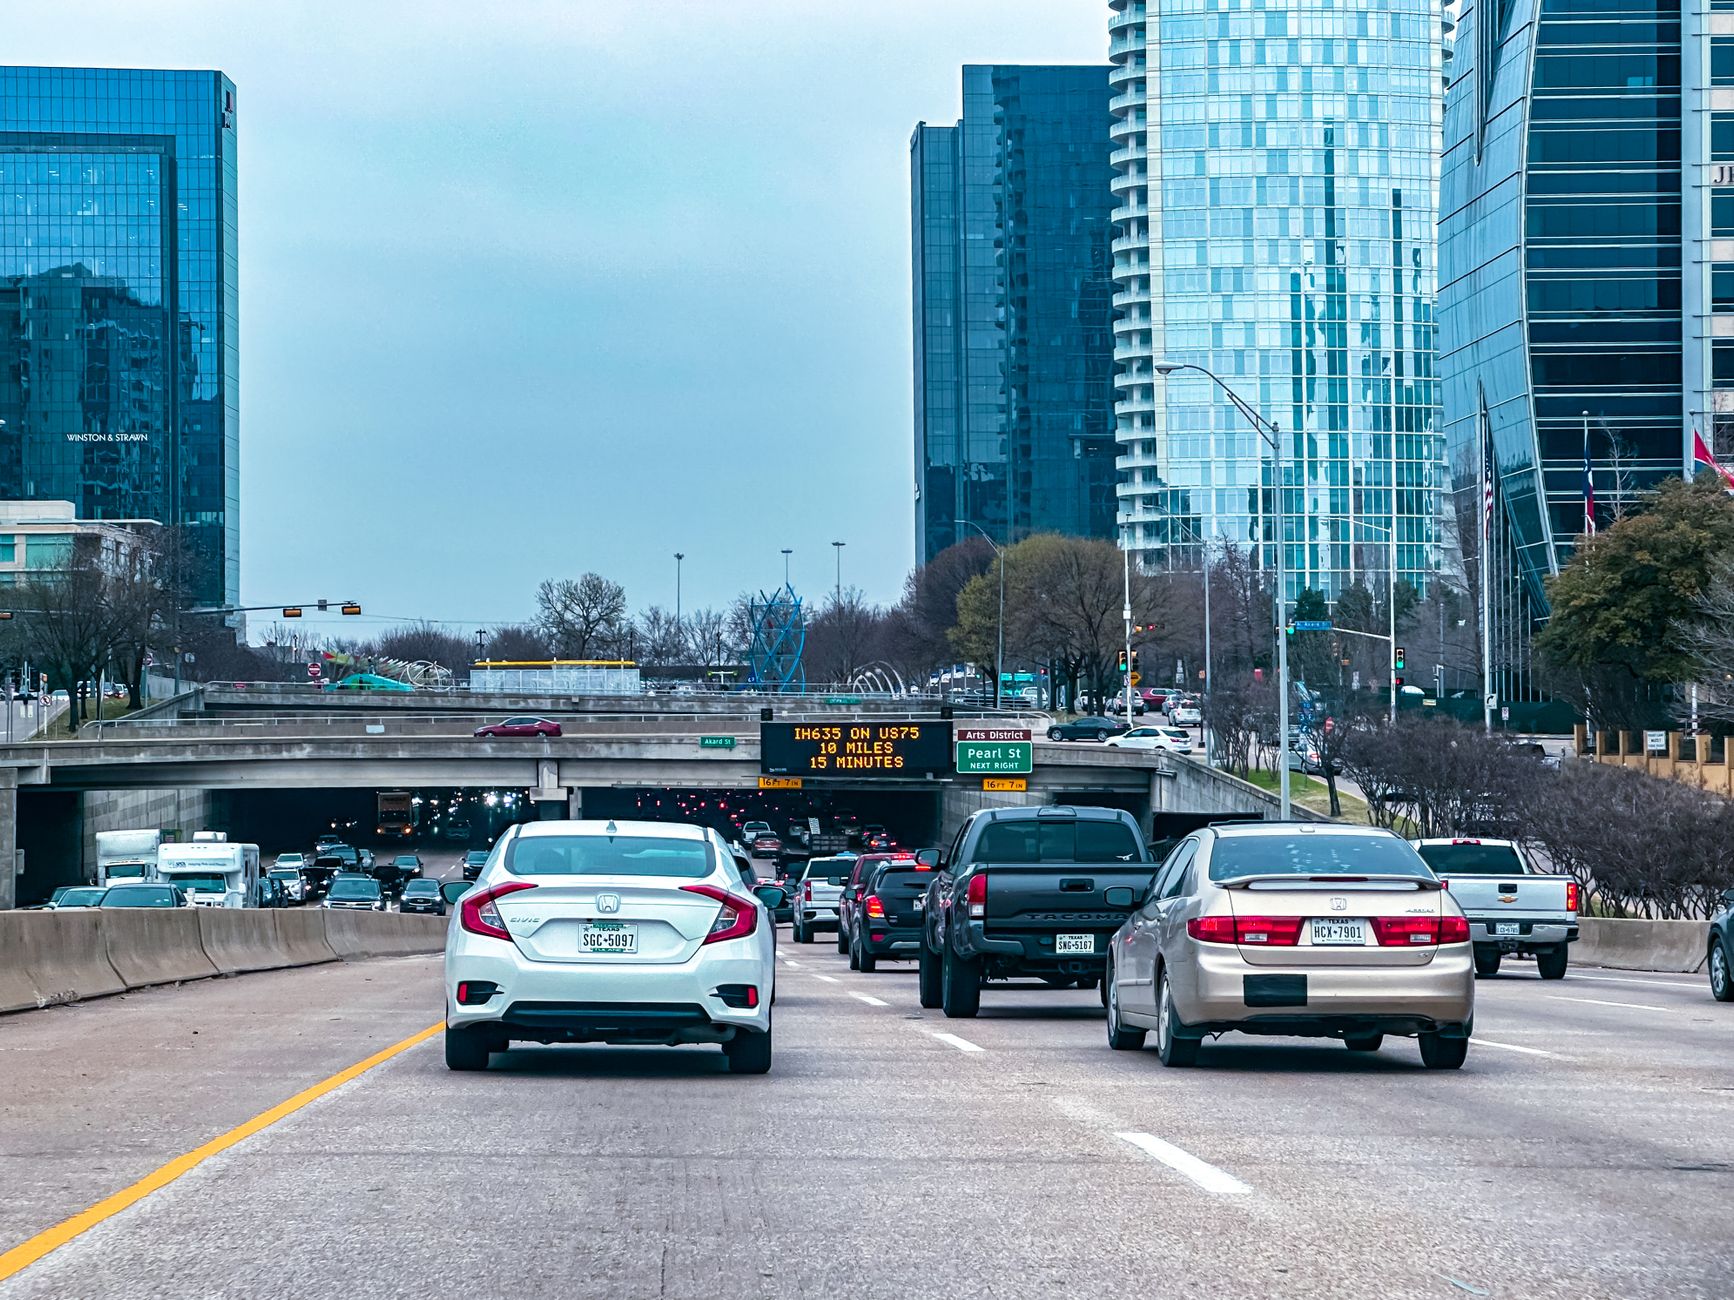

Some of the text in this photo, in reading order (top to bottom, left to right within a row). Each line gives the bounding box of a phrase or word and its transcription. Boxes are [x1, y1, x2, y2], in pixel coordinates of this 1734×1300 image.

[66, 433, 148, 442] WINSTON & STRAWN
[794, 727, 919, 740] IH635 ON US75
[966, 731, 1024, 739] Arts District
[820, 742, 893, 754] 10 MILES
[967, 748, 1021, 759] Pearl St
[810, 756, 904, 768] 15 MINUTES
